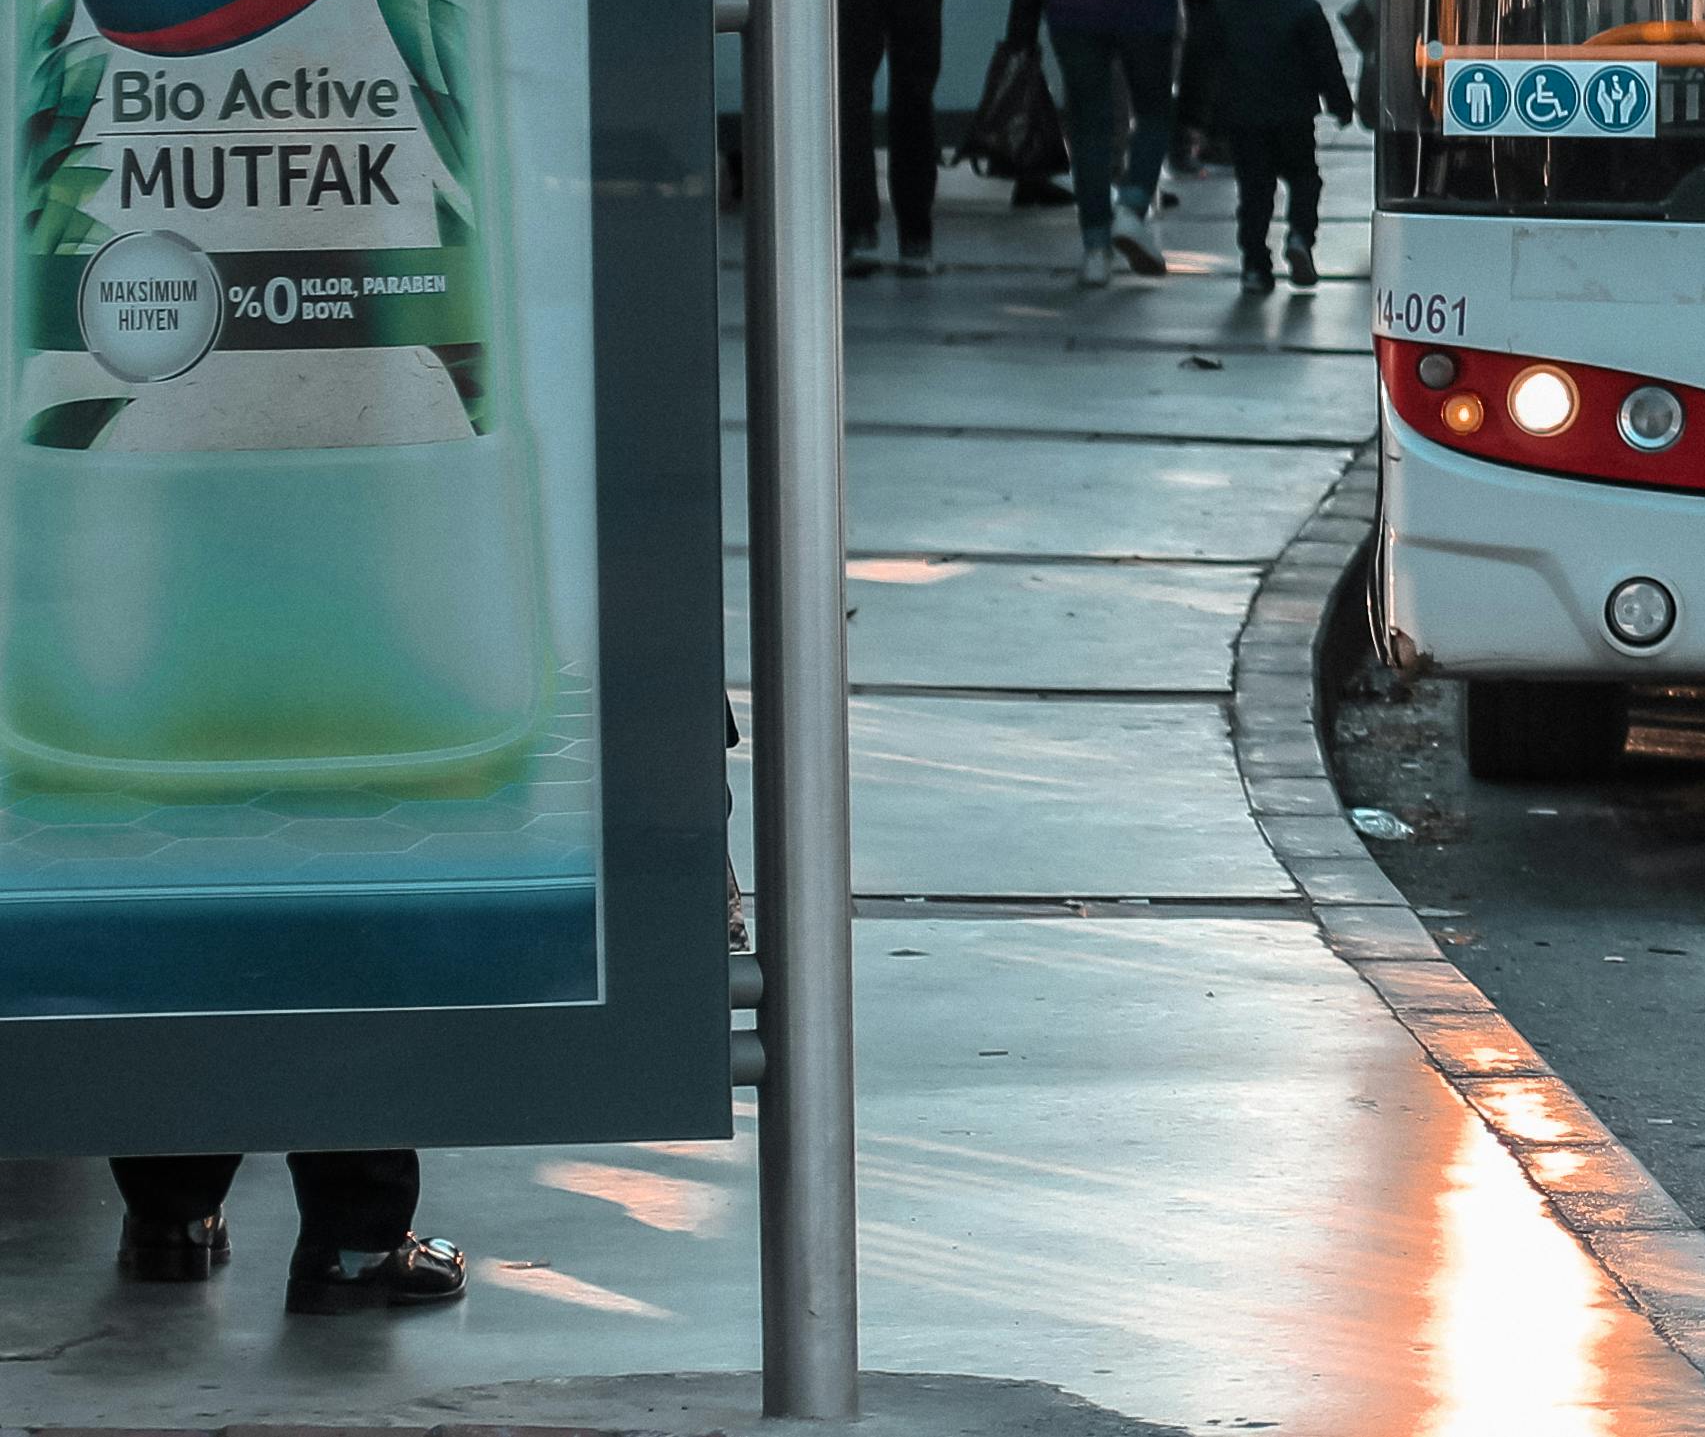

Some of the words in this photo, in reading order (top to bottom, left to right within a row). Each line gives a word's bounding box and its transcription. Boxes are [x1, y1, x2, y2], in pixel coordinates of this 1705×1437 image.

[112, 68, 204, 124] Bio
[217, 66, 399, 121] Active
[120, 142, 400, 209] MUTFAK
[100, 278, 198, 304] MAKSİMUM
[301, 277, 359, 299] KLOR,
[362, 275, 446, 296] PARABEN
[118, 308, 179, 332] HİJYEN
[301, 301, 354, 320] BOYA
[1377, 287, 1467, 337] 14-061
